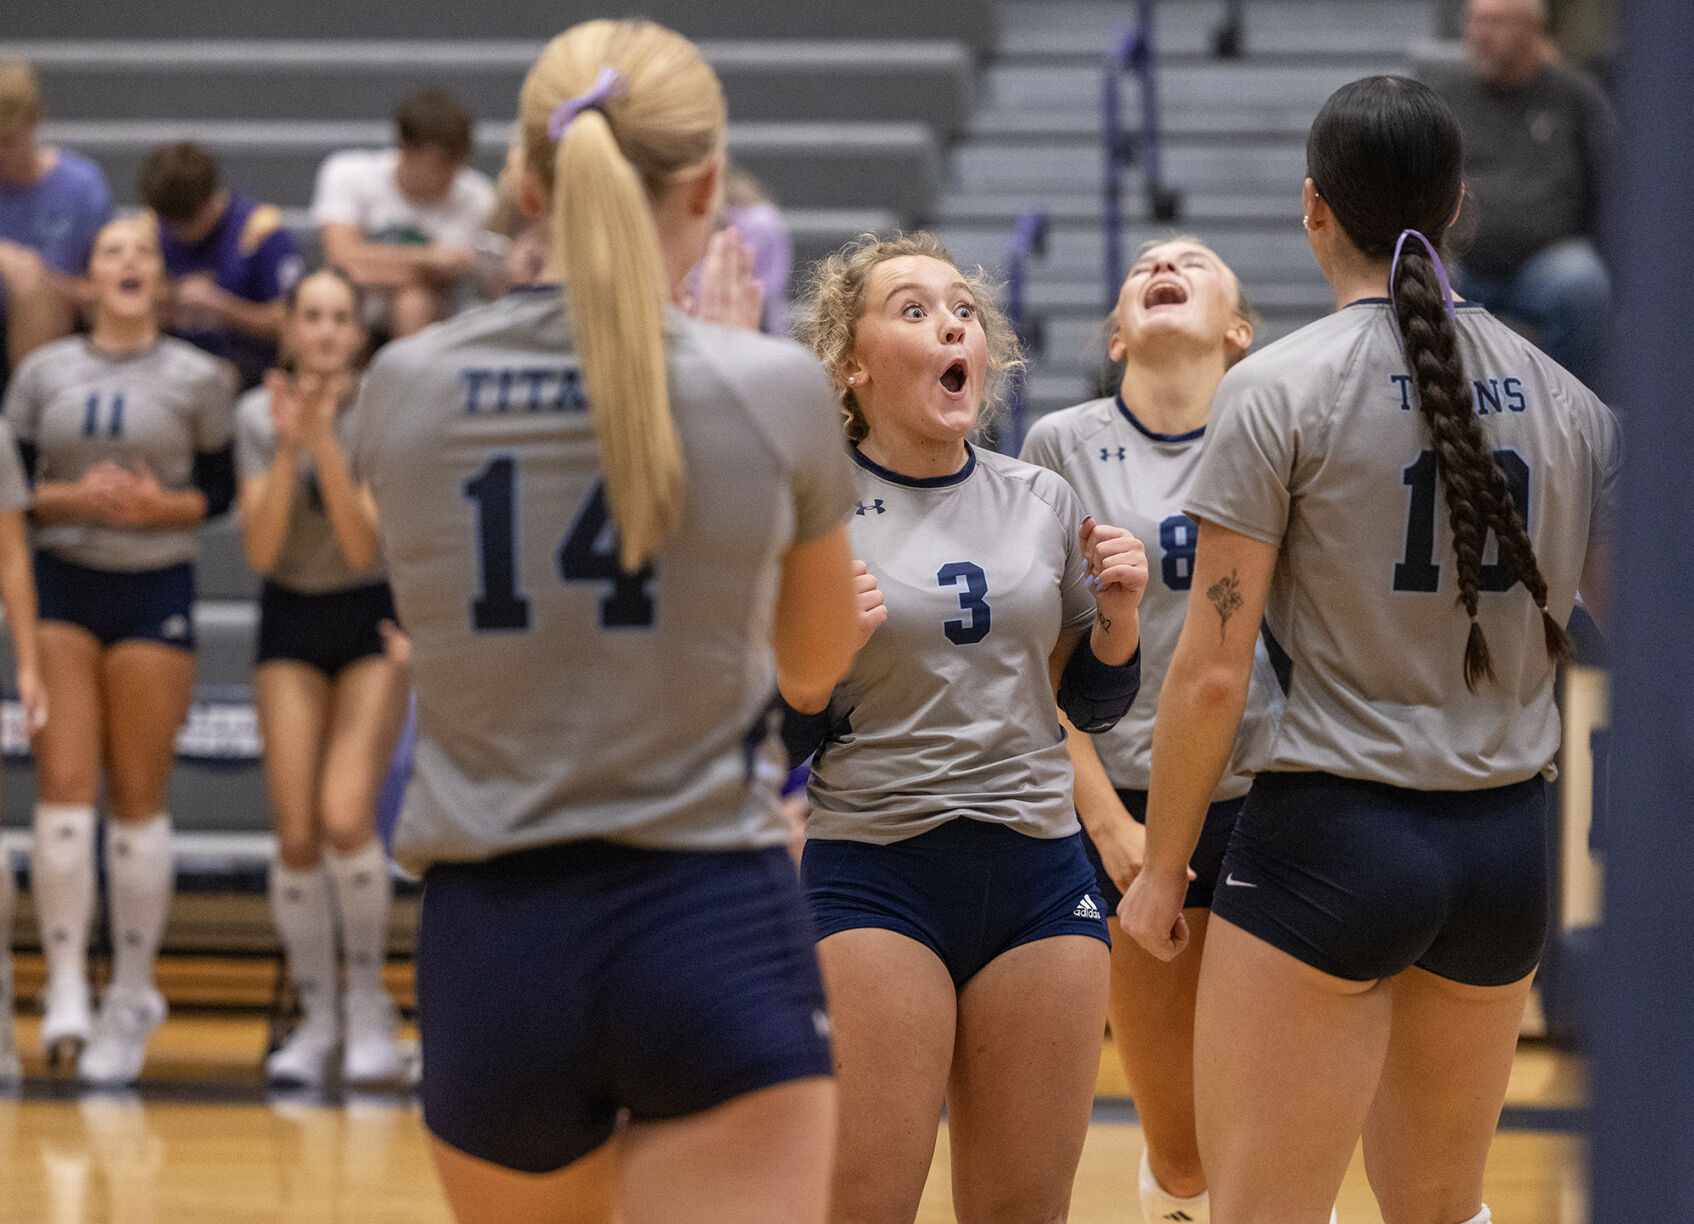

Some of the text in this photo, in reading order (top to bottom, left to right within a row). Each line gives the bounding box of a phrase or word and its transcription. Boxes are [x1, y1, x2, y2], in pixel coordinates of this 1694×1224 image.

[82, 391, 126, 438] 11
[461, 367, 590, 414] TITA
[1391, 374, 1526, 415] TNS
[464, 452, 656, 632] 14
[1158, 514, 1199, 591] 8
[936, 560, 992, 647] 3
